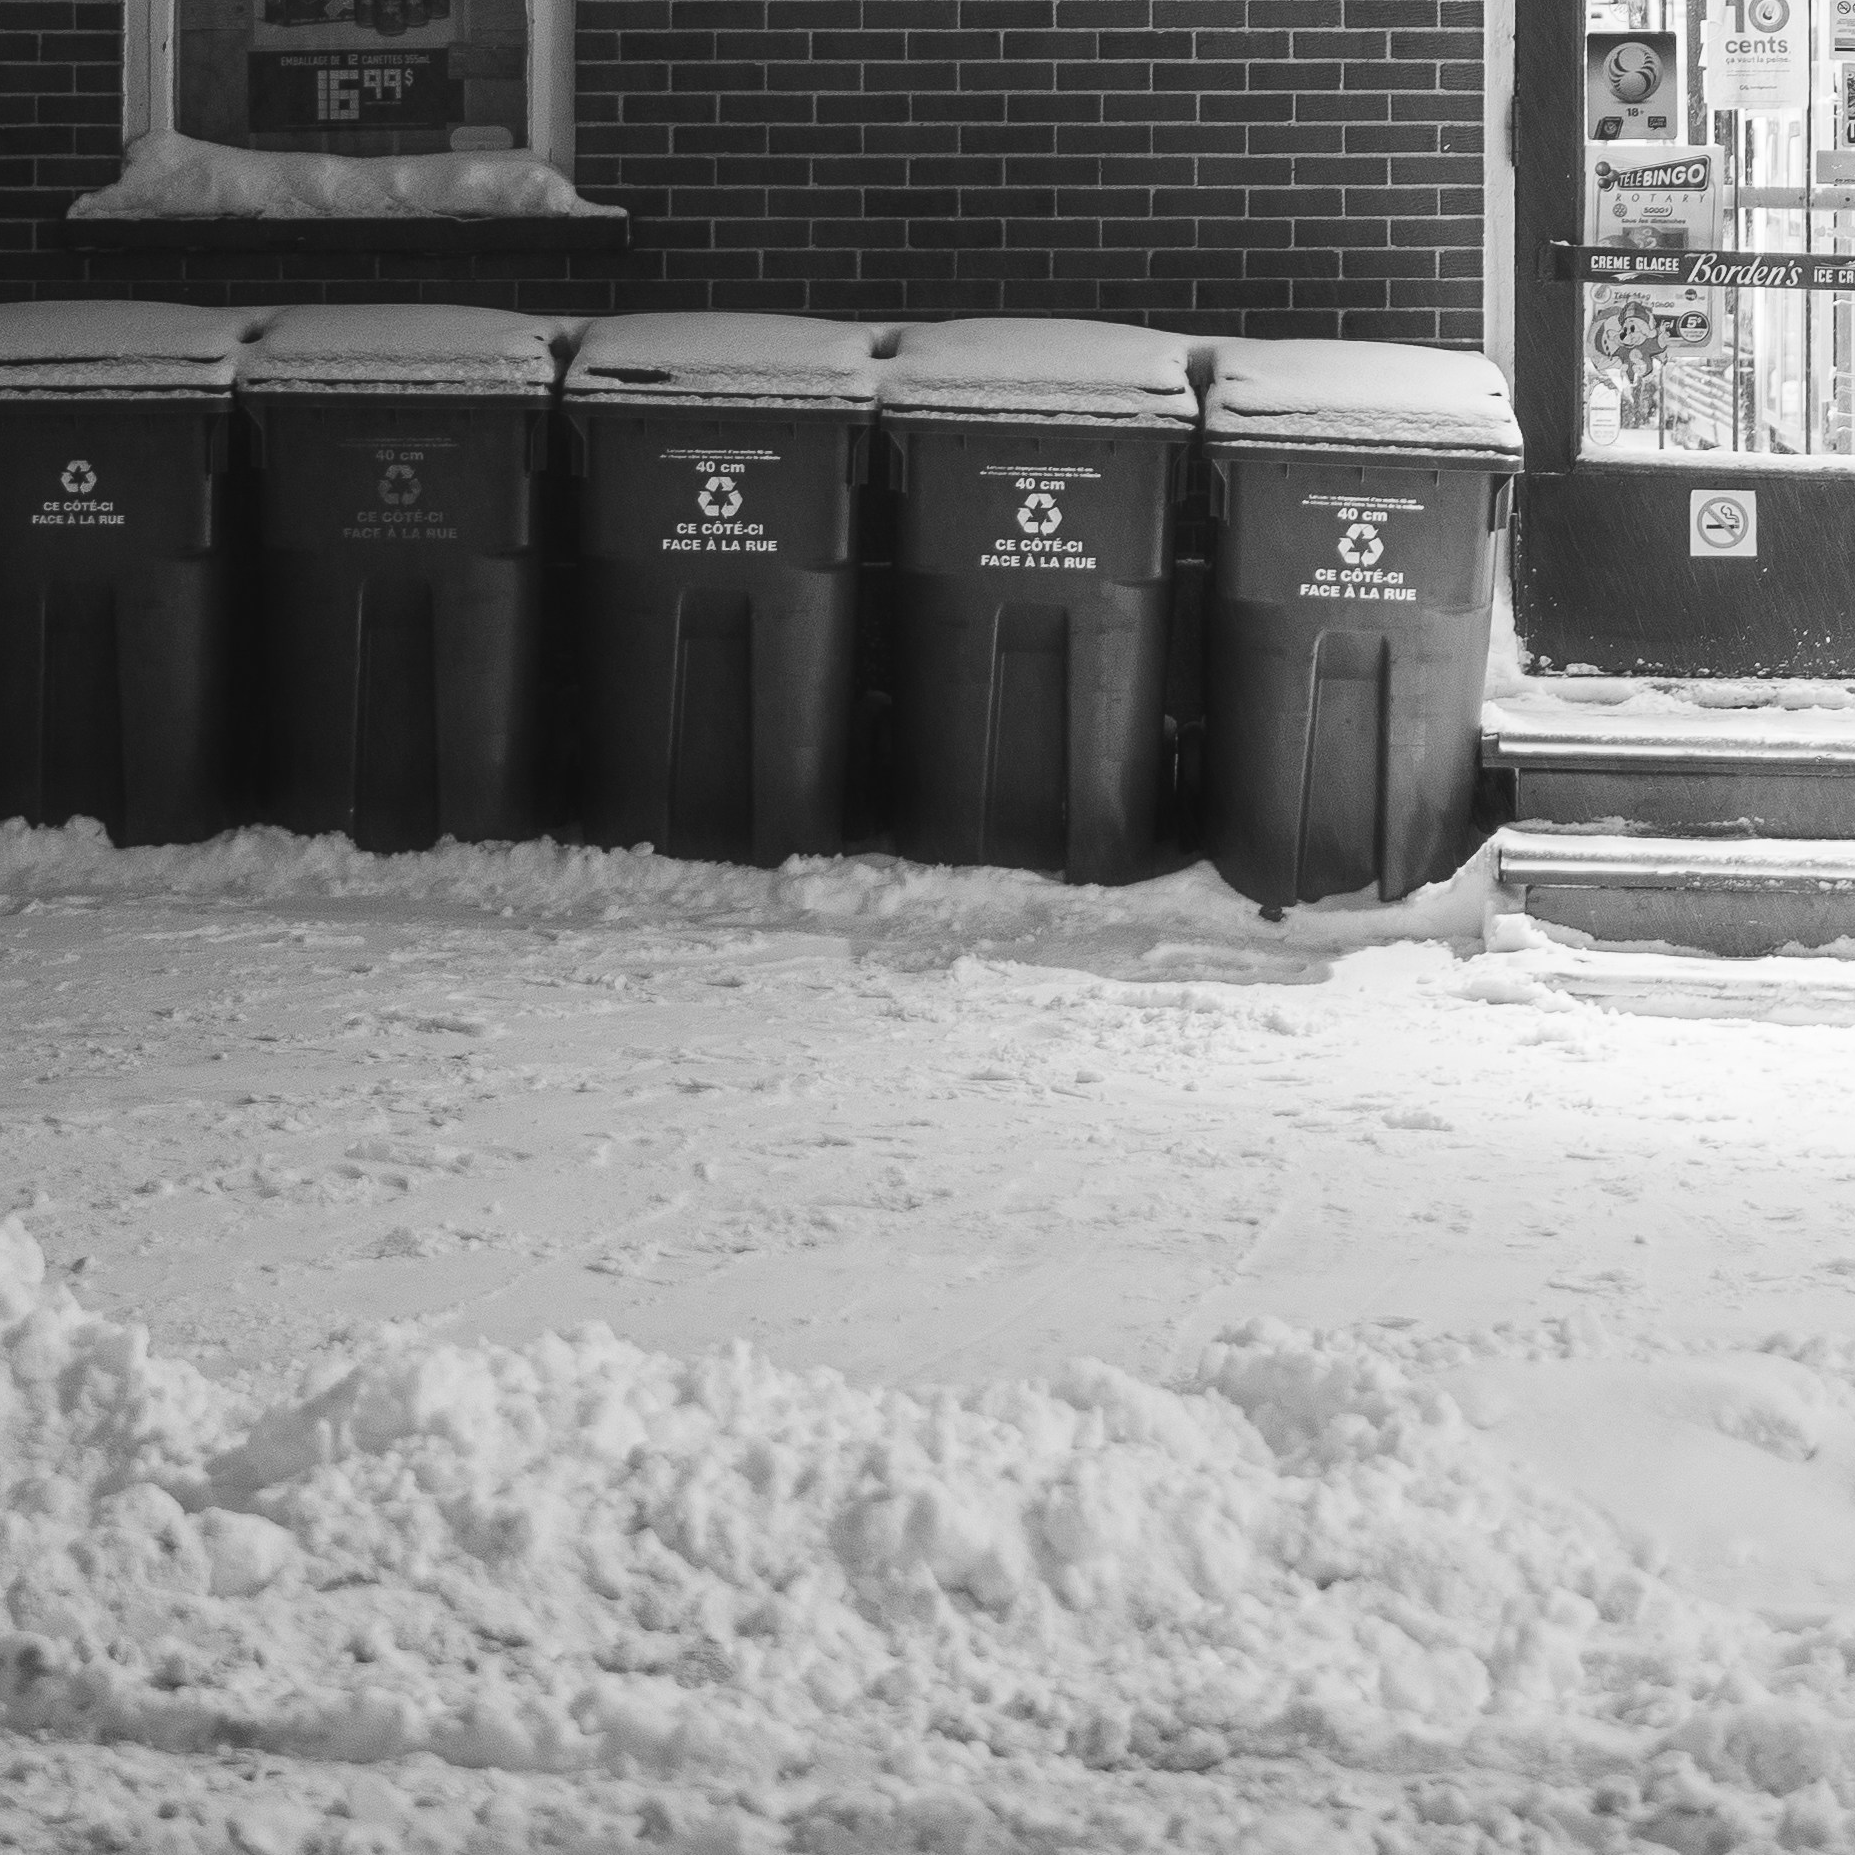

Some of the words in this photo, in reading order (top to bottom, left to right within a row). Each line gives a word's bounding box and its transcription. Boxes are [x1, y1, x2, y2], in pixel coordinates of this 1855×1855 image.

[1618, 163, 1706, 188] TÉLÉBINGO
[1590, 254, 1632, 270] CREME
[1635, 255, 1680, 272] GLACEE
[1683, 252, 1803, 287] Borden's
[1813, 268, 1834, 284] ICE
[695, 460, 716, 473] 40
[720, 463, 746, 473] cm
[1015, 477, 1036, 490] 40
[1039, 480, 1066, 490] cm
[43, 502, 60, 511] CE
[63, 499, 114, 511] CÔTÉ-CI
[32, 515, 64, 524] FACE
[67, 513, 76, 524] À
[79, 515, 95, 524] LA
[98, 515, 125, 524] RUE
[1337, 507, 1358, 521] 40
[1361, 510, 1388, 522] cm
[676, 522, 697, 534] CE
[701, 520, 764, 535] CÔTÉ-CI
[662, 539, 702, 550] FACE
[706, 536, 717, 551] À
[721, 539, 741, 551] LA
[745, 540, 778, 551] RUE
[995, 539, 1017, 551] CE
[1020, 537, 1083, 552] CÔTÉ-CI
[980, 554, 1021, 566] FACE
[1024, 552, 1036, 567] À
[1040, 556, 1060, 567] LA
[1063, 557, 1097, 569] RUE
[1314, 568, 1337, 581] CE
[1340, 567, 1404, 584] CÔTÉ-CI
[1299, 583, 1341, 597] FACE
[1343, 583, 1356, 598] À
[1359, 587, 1380, 600] LA
[1383, 588, 1417, 601] RUE
